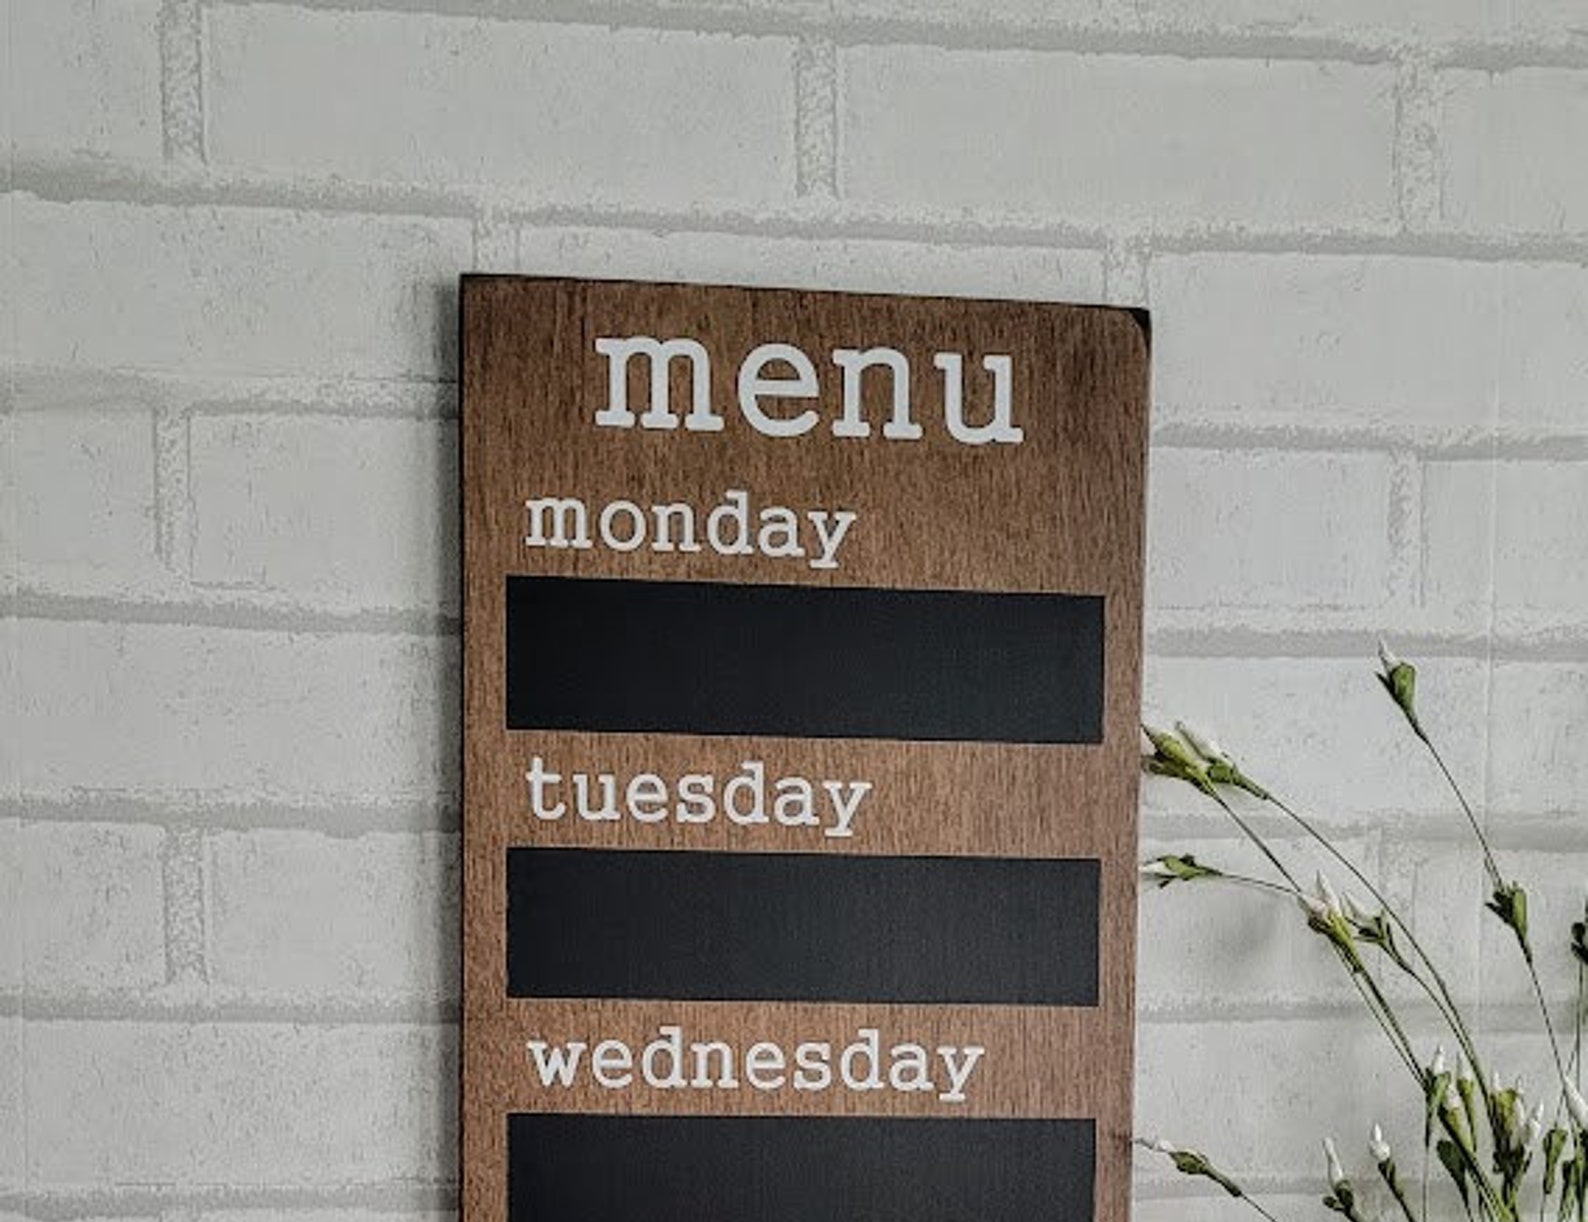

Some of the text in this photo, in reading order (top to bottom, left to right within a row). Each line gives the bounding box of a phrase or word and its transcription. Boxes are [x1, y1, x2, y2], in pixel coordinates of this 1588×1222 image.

[595, 335, 1024, 445] menu
[526, 490, 857, 569] monday
[527, 756, 873, 836] tuesday
[527, 1026, 985, 1101] wednesday
